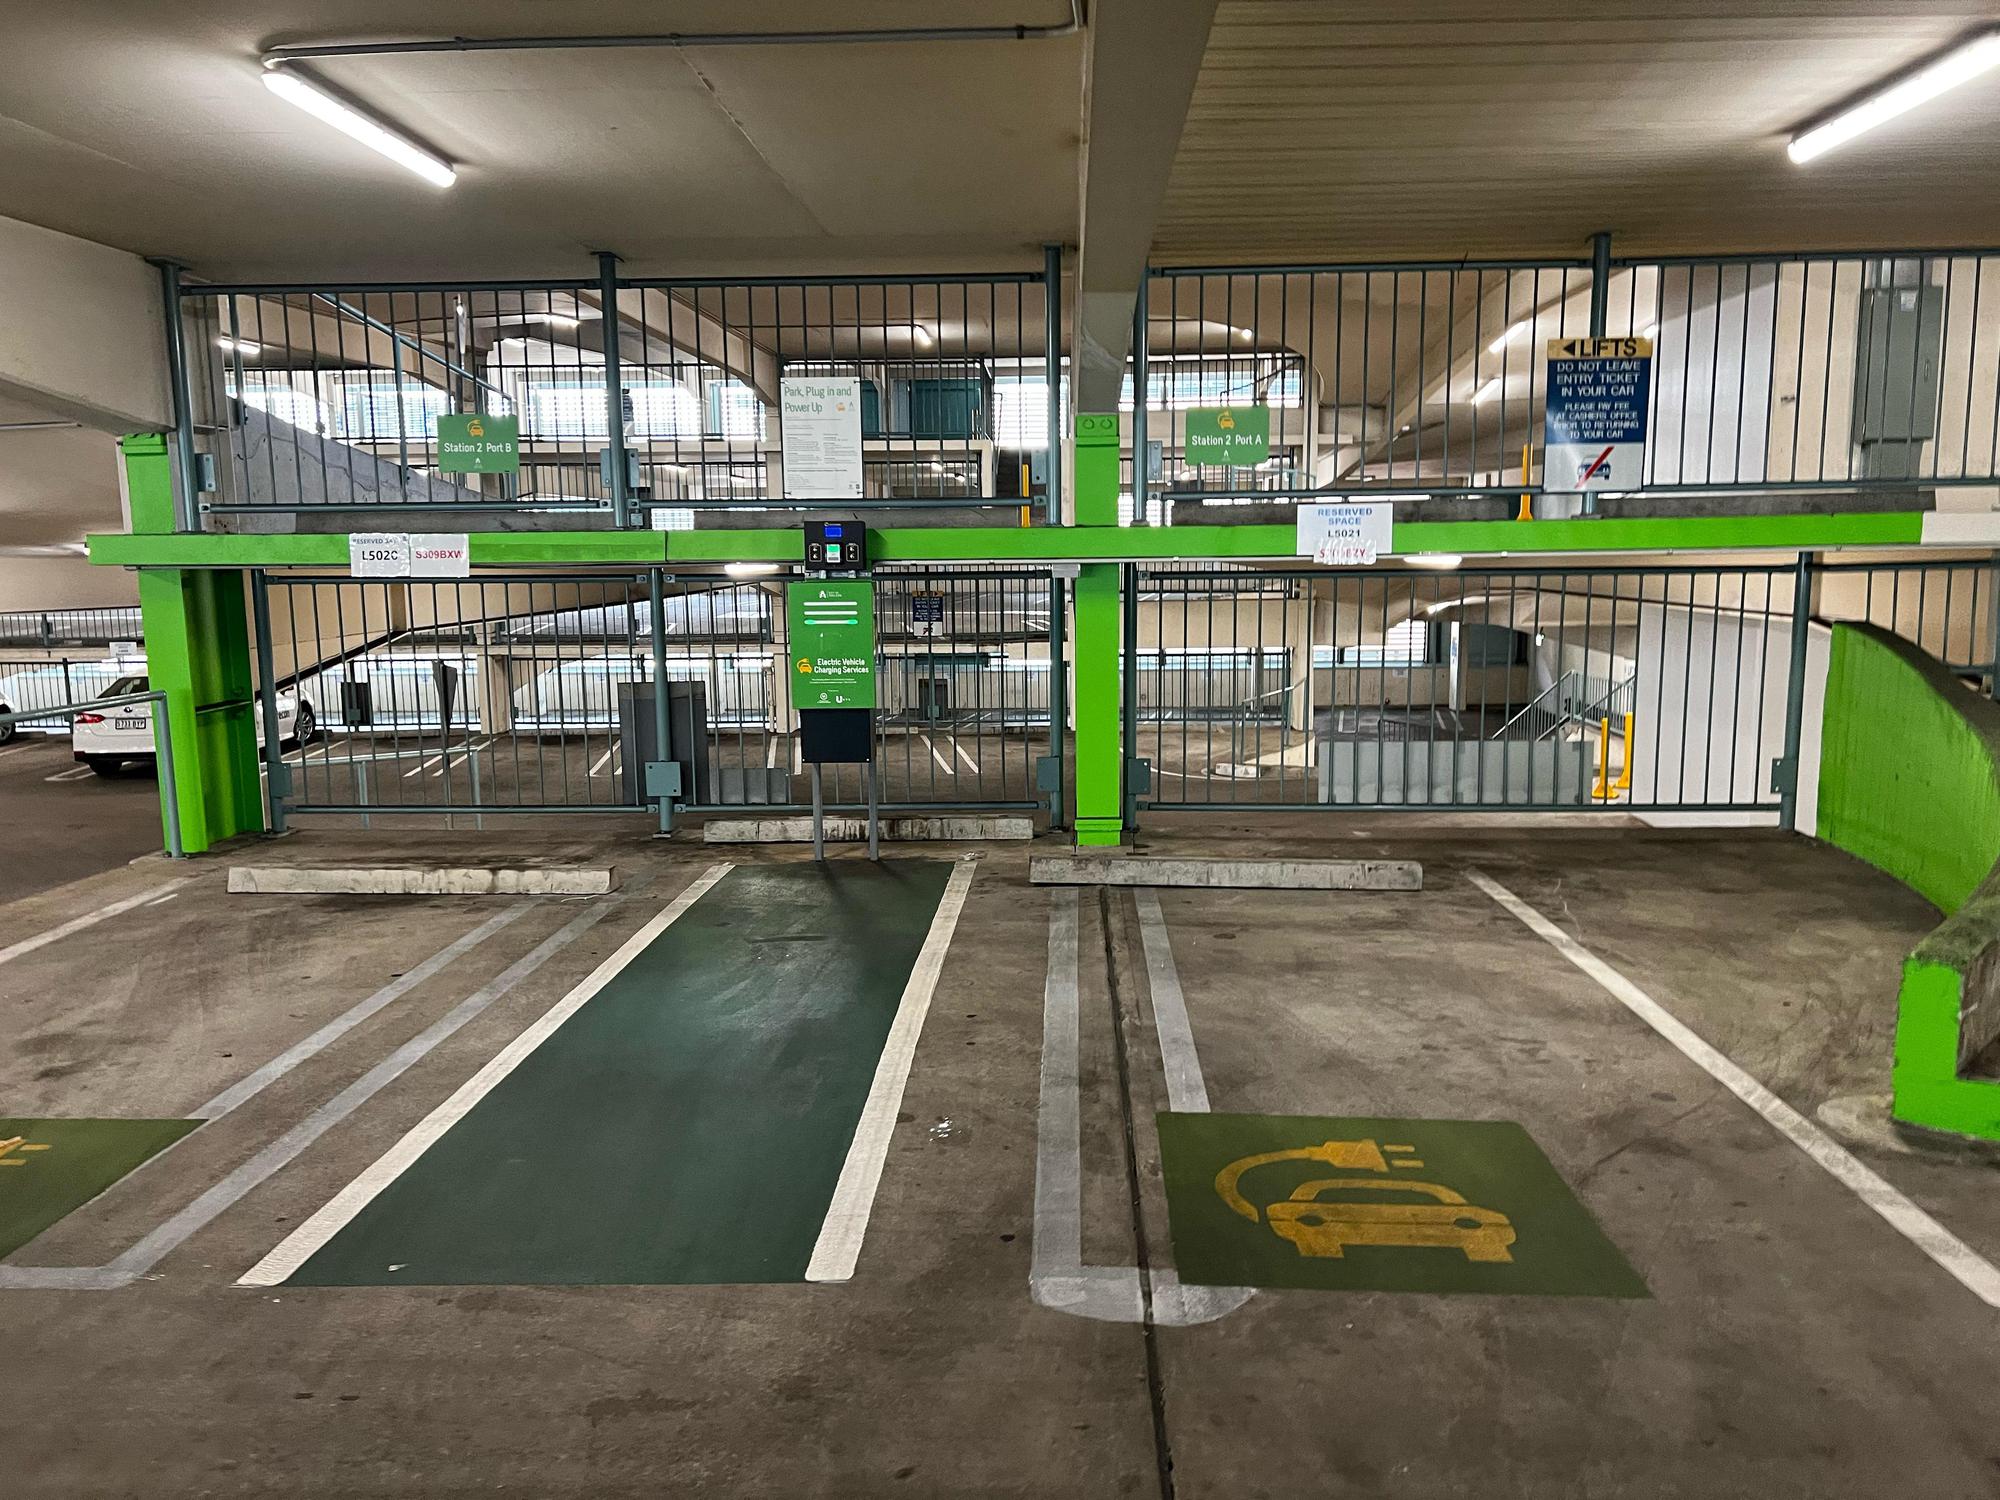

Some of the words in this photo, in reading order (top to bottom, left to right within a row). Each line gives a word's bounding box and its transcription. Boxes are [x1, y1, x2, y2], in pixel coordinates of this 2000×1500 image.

[1580, 338, 1637, 357] LIFTS
[1556, 361, 1574, 372] DO
[1578, 361, 1601, 372] NOT
[1606, 361, 1640, 371] LEAVE
[1556, 373, 1594, 385] ENTRY
[1600, 373, 1640, 384] TICKET
[784, 387, 804, 397] Park,
[806, 387, 825, 399] Plug
[827, 386, 834, 396] in
[836, 386, 852, 396] and
[1561, 386, 1572, 397] IN
[1577, 385, 1606, 396] YOUR
[1611, 385, 1634, 396] CAR
[784, 402, 810, 413] Power
[812, 402, 823, 414] Up
[1564, 402, 1595, 412] PLEASE
[1614, 402, 1630, 411] FEE
[1610, 411, 1638, 420] OFFICE
[1581, 421, 1591, 430] TO
[1569, 430, 1580, 439] TO
[1583, 430, 1604, 439] YOUR
[1606, 430, 1623, 439] CAR
[1191, 435, 1223, 446] Station
[1225, 434, 1231, 446] 2
[1235, 434, 1253, 446] Port
[1255, 434, 1262, 445] A
[444, 442, 475, 453] Station
[476, 442, 483, 453] 2
[486, 442, 504, 453] Port
[505, 442, 512, 453] B
[1317, 508, 1373, 516] RESERVED
[1328, 517, 1362, 525] SPACE
[1327, 529, 1361, 538] L5021
[415, 550, 464, 559] S309BXW
[817, 658, 841, 666] Electric
[842, 658, 865, 666] Vehicle
[813, 666, 842, 675] Charging
[843, 666, 869, 674] Services
